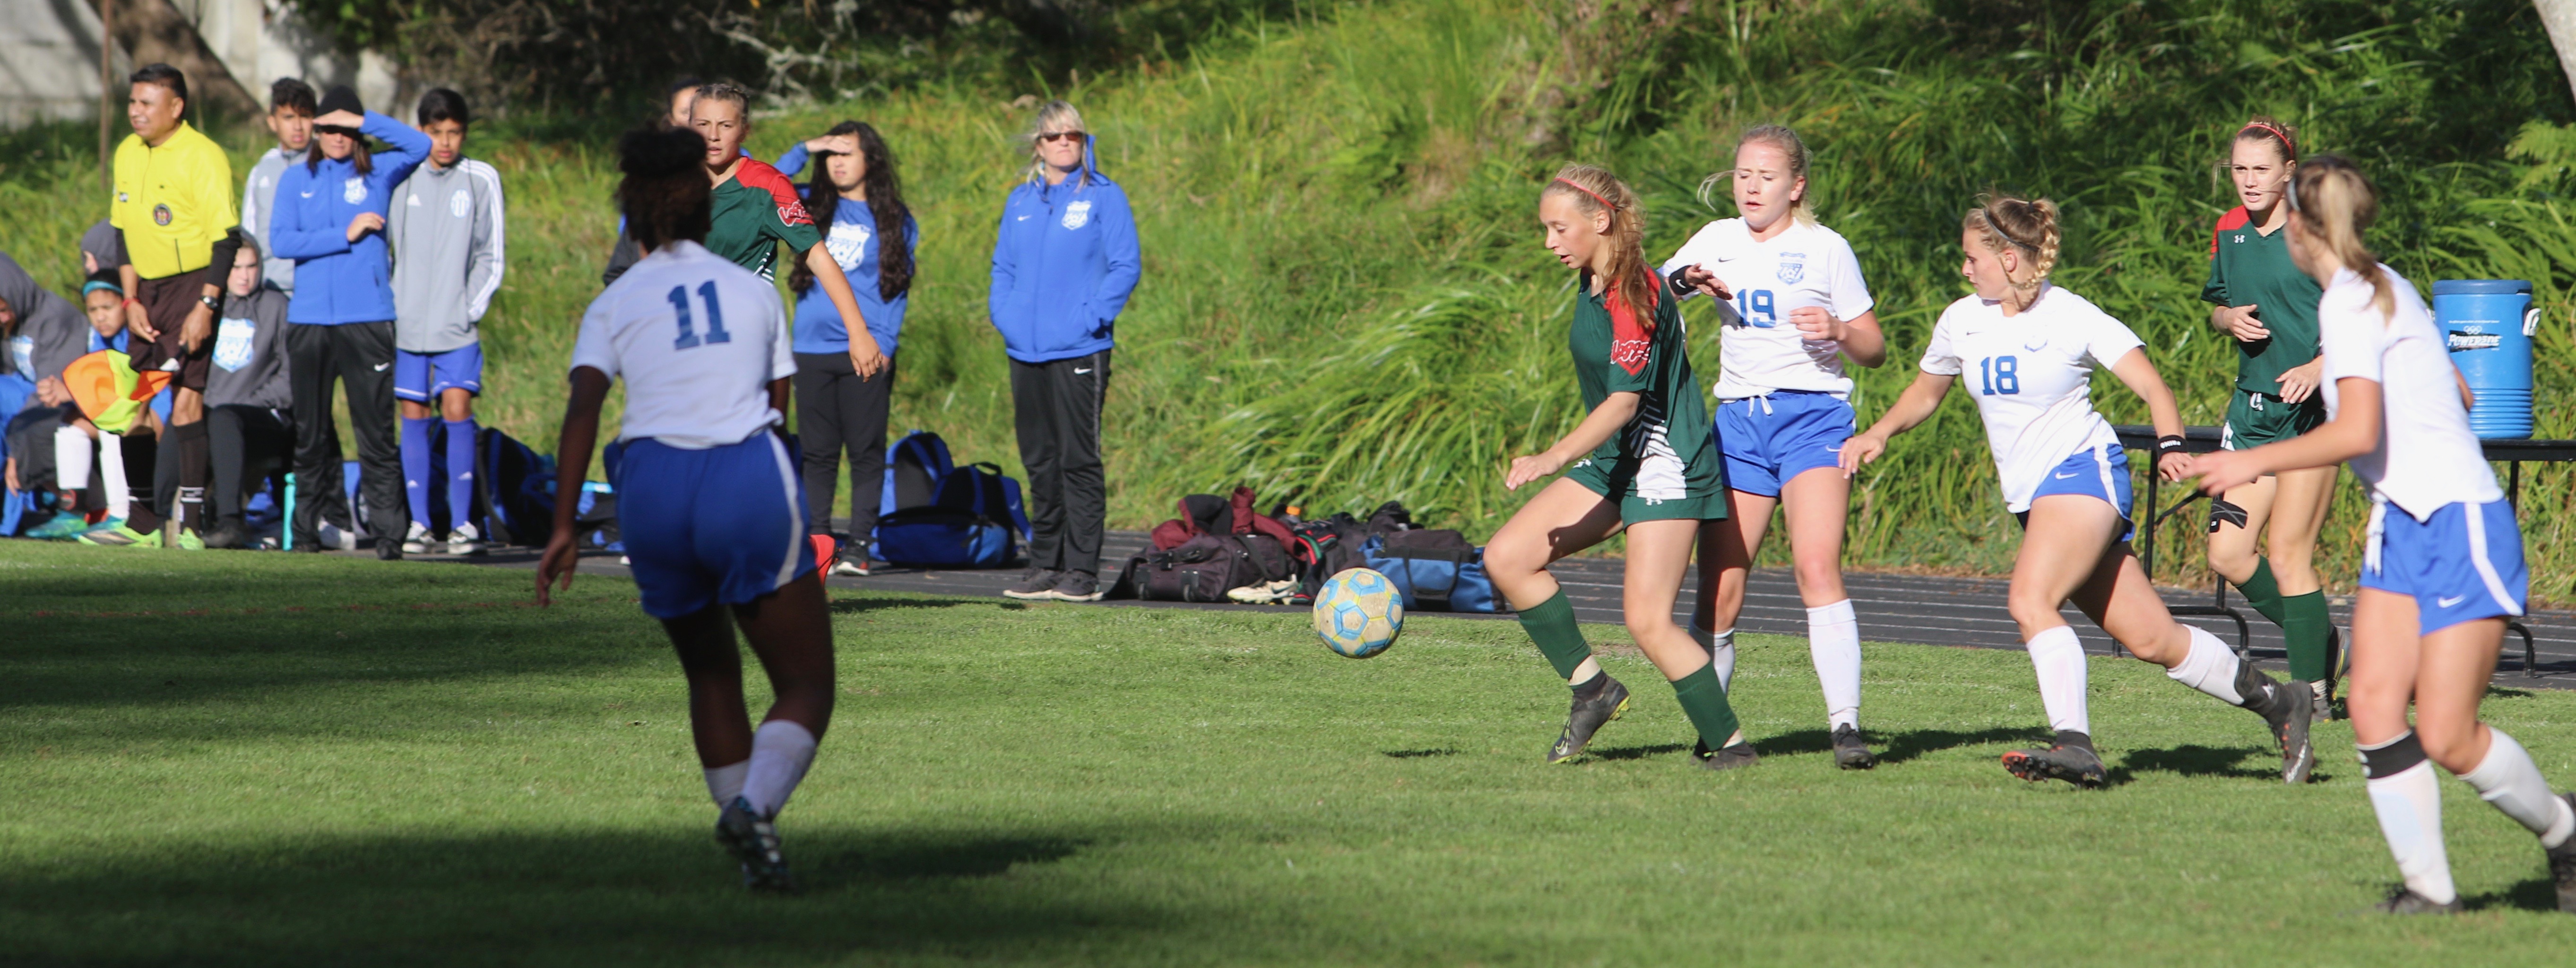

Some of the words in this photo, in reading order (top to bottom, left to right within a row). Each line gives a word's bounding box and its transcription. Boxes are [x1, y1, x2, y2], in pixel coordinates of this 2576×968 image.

[667, 279, 731, 351] 11
[1737, 288, 1776, 328] 19
[1980, 355, 2020, 395] 18
